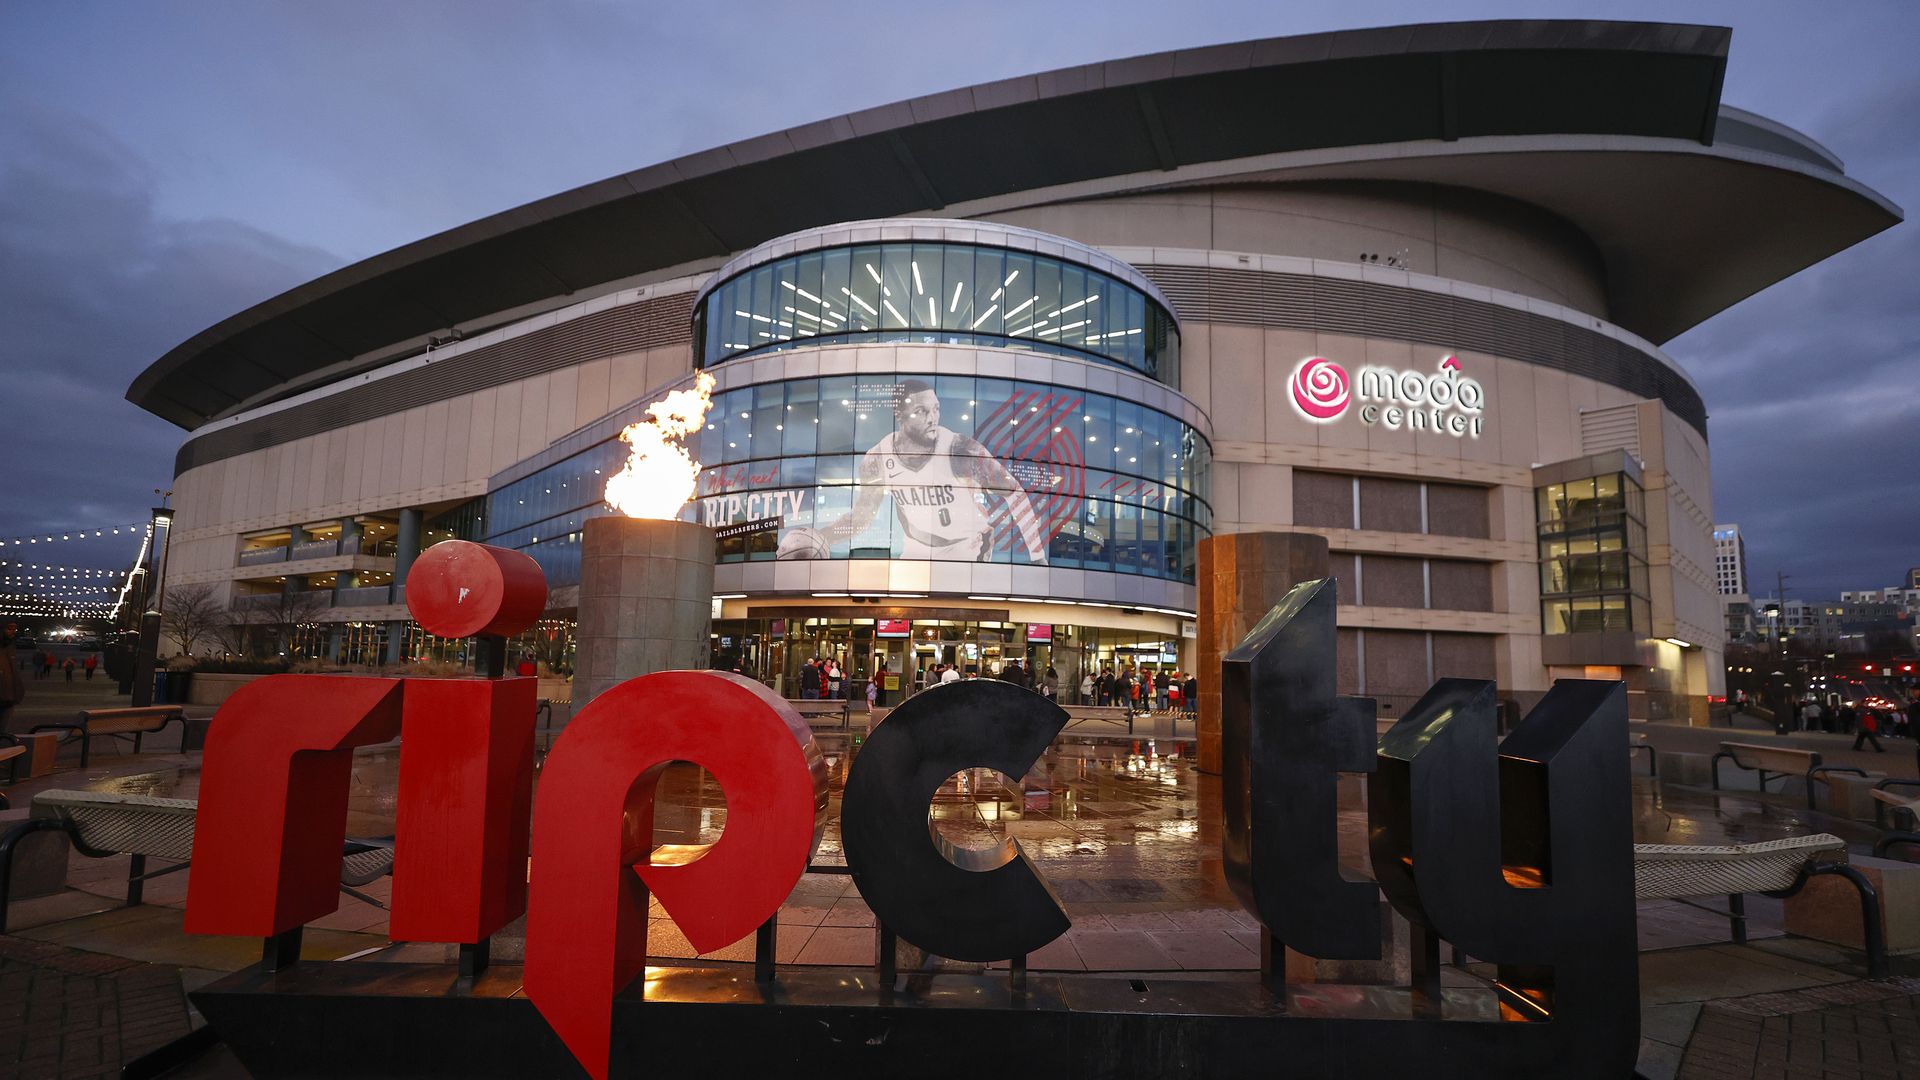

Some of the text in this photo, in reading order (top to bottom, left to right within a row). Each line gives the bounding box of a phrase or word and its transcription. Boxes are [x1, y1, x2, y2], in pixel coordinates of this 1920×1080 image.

[1361, 354, 1485, 409] moda
[1362, 404, 1484, 435] center
[749, 465, 779, 485] next
[891, 484, 955, 506] BLAZERS
[704, 490, 805, 528] RIP CITY
[938, 507, 952, 527] 0
